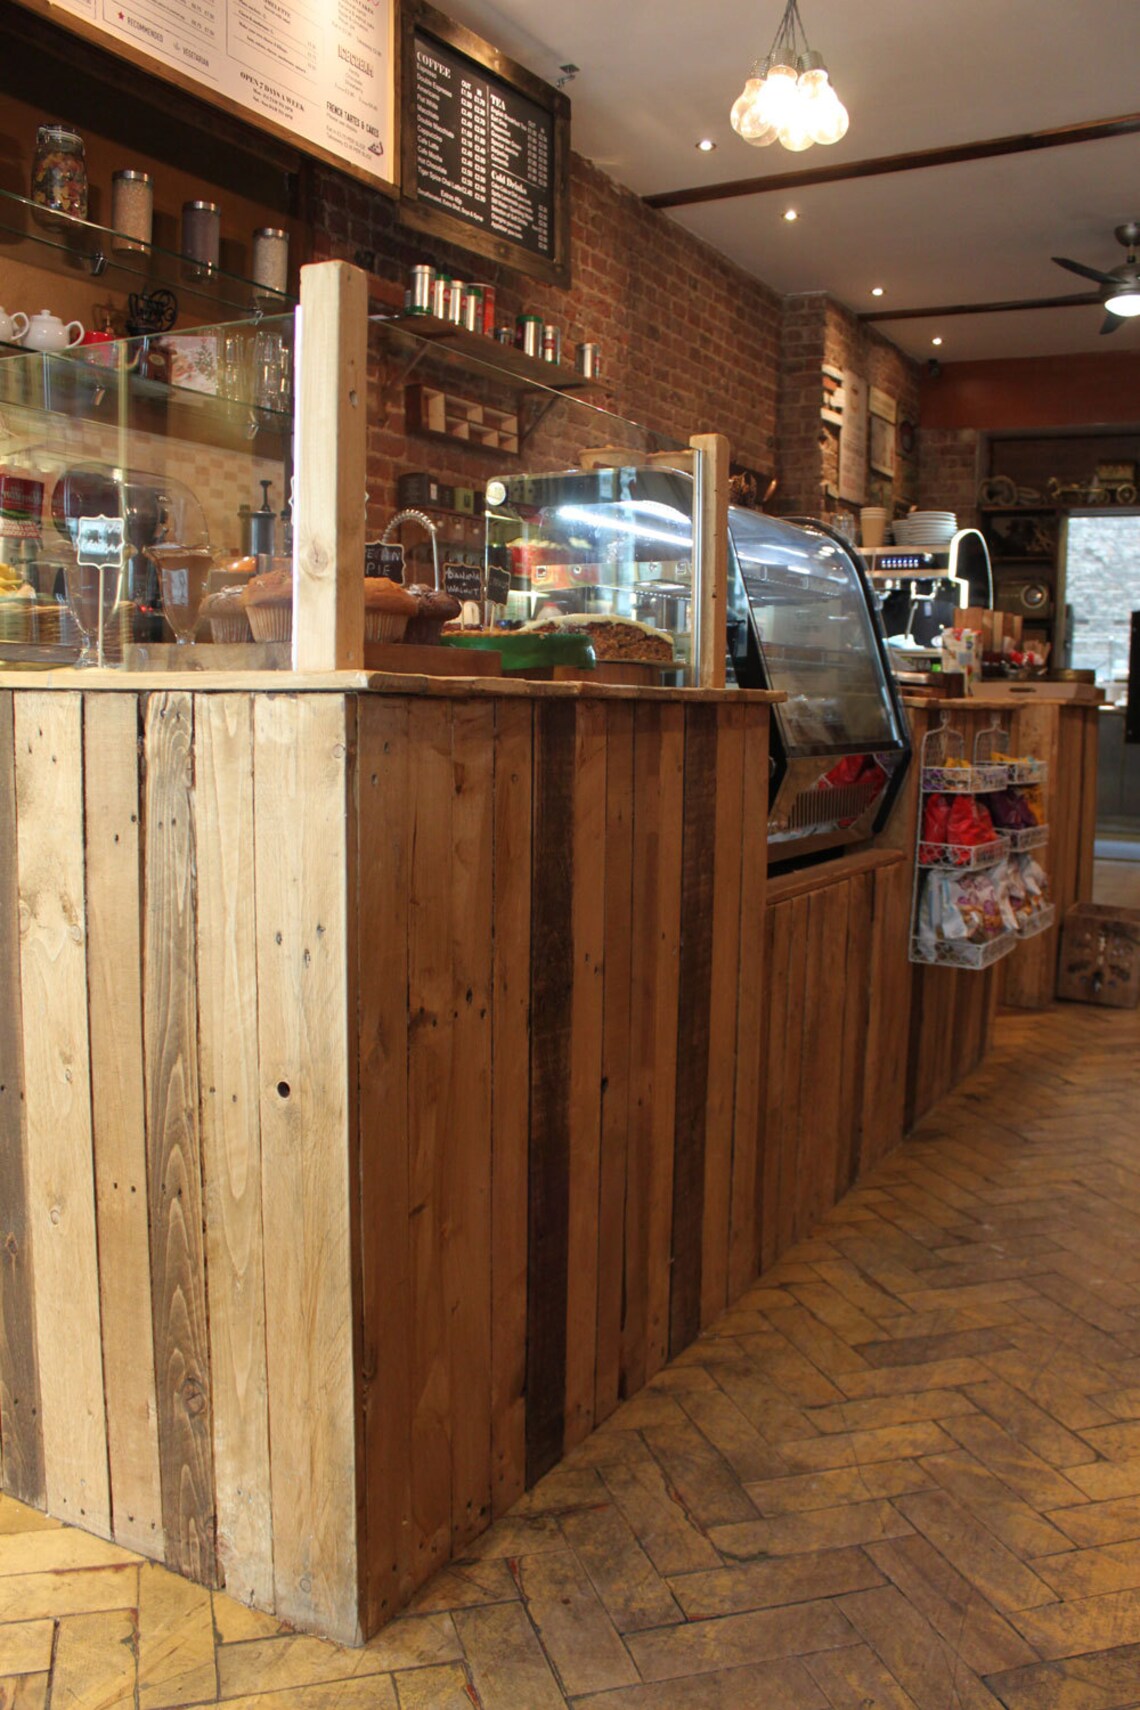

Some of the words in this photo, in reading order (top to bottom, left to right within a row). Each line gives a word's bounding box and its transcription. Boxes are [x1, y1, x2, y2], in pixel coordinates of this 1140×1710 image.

[417, 51, 451, 79] COFFEE
[326, 101, 343, 118] FRENCH
[490, 93, 506, 111] TEA
[490, 170, 506, 185] Cold
[506, 177, 527, 195] Drinks
[366, 563, 391, 577] PIE
[446, 585, 479, 596] WALNUT
